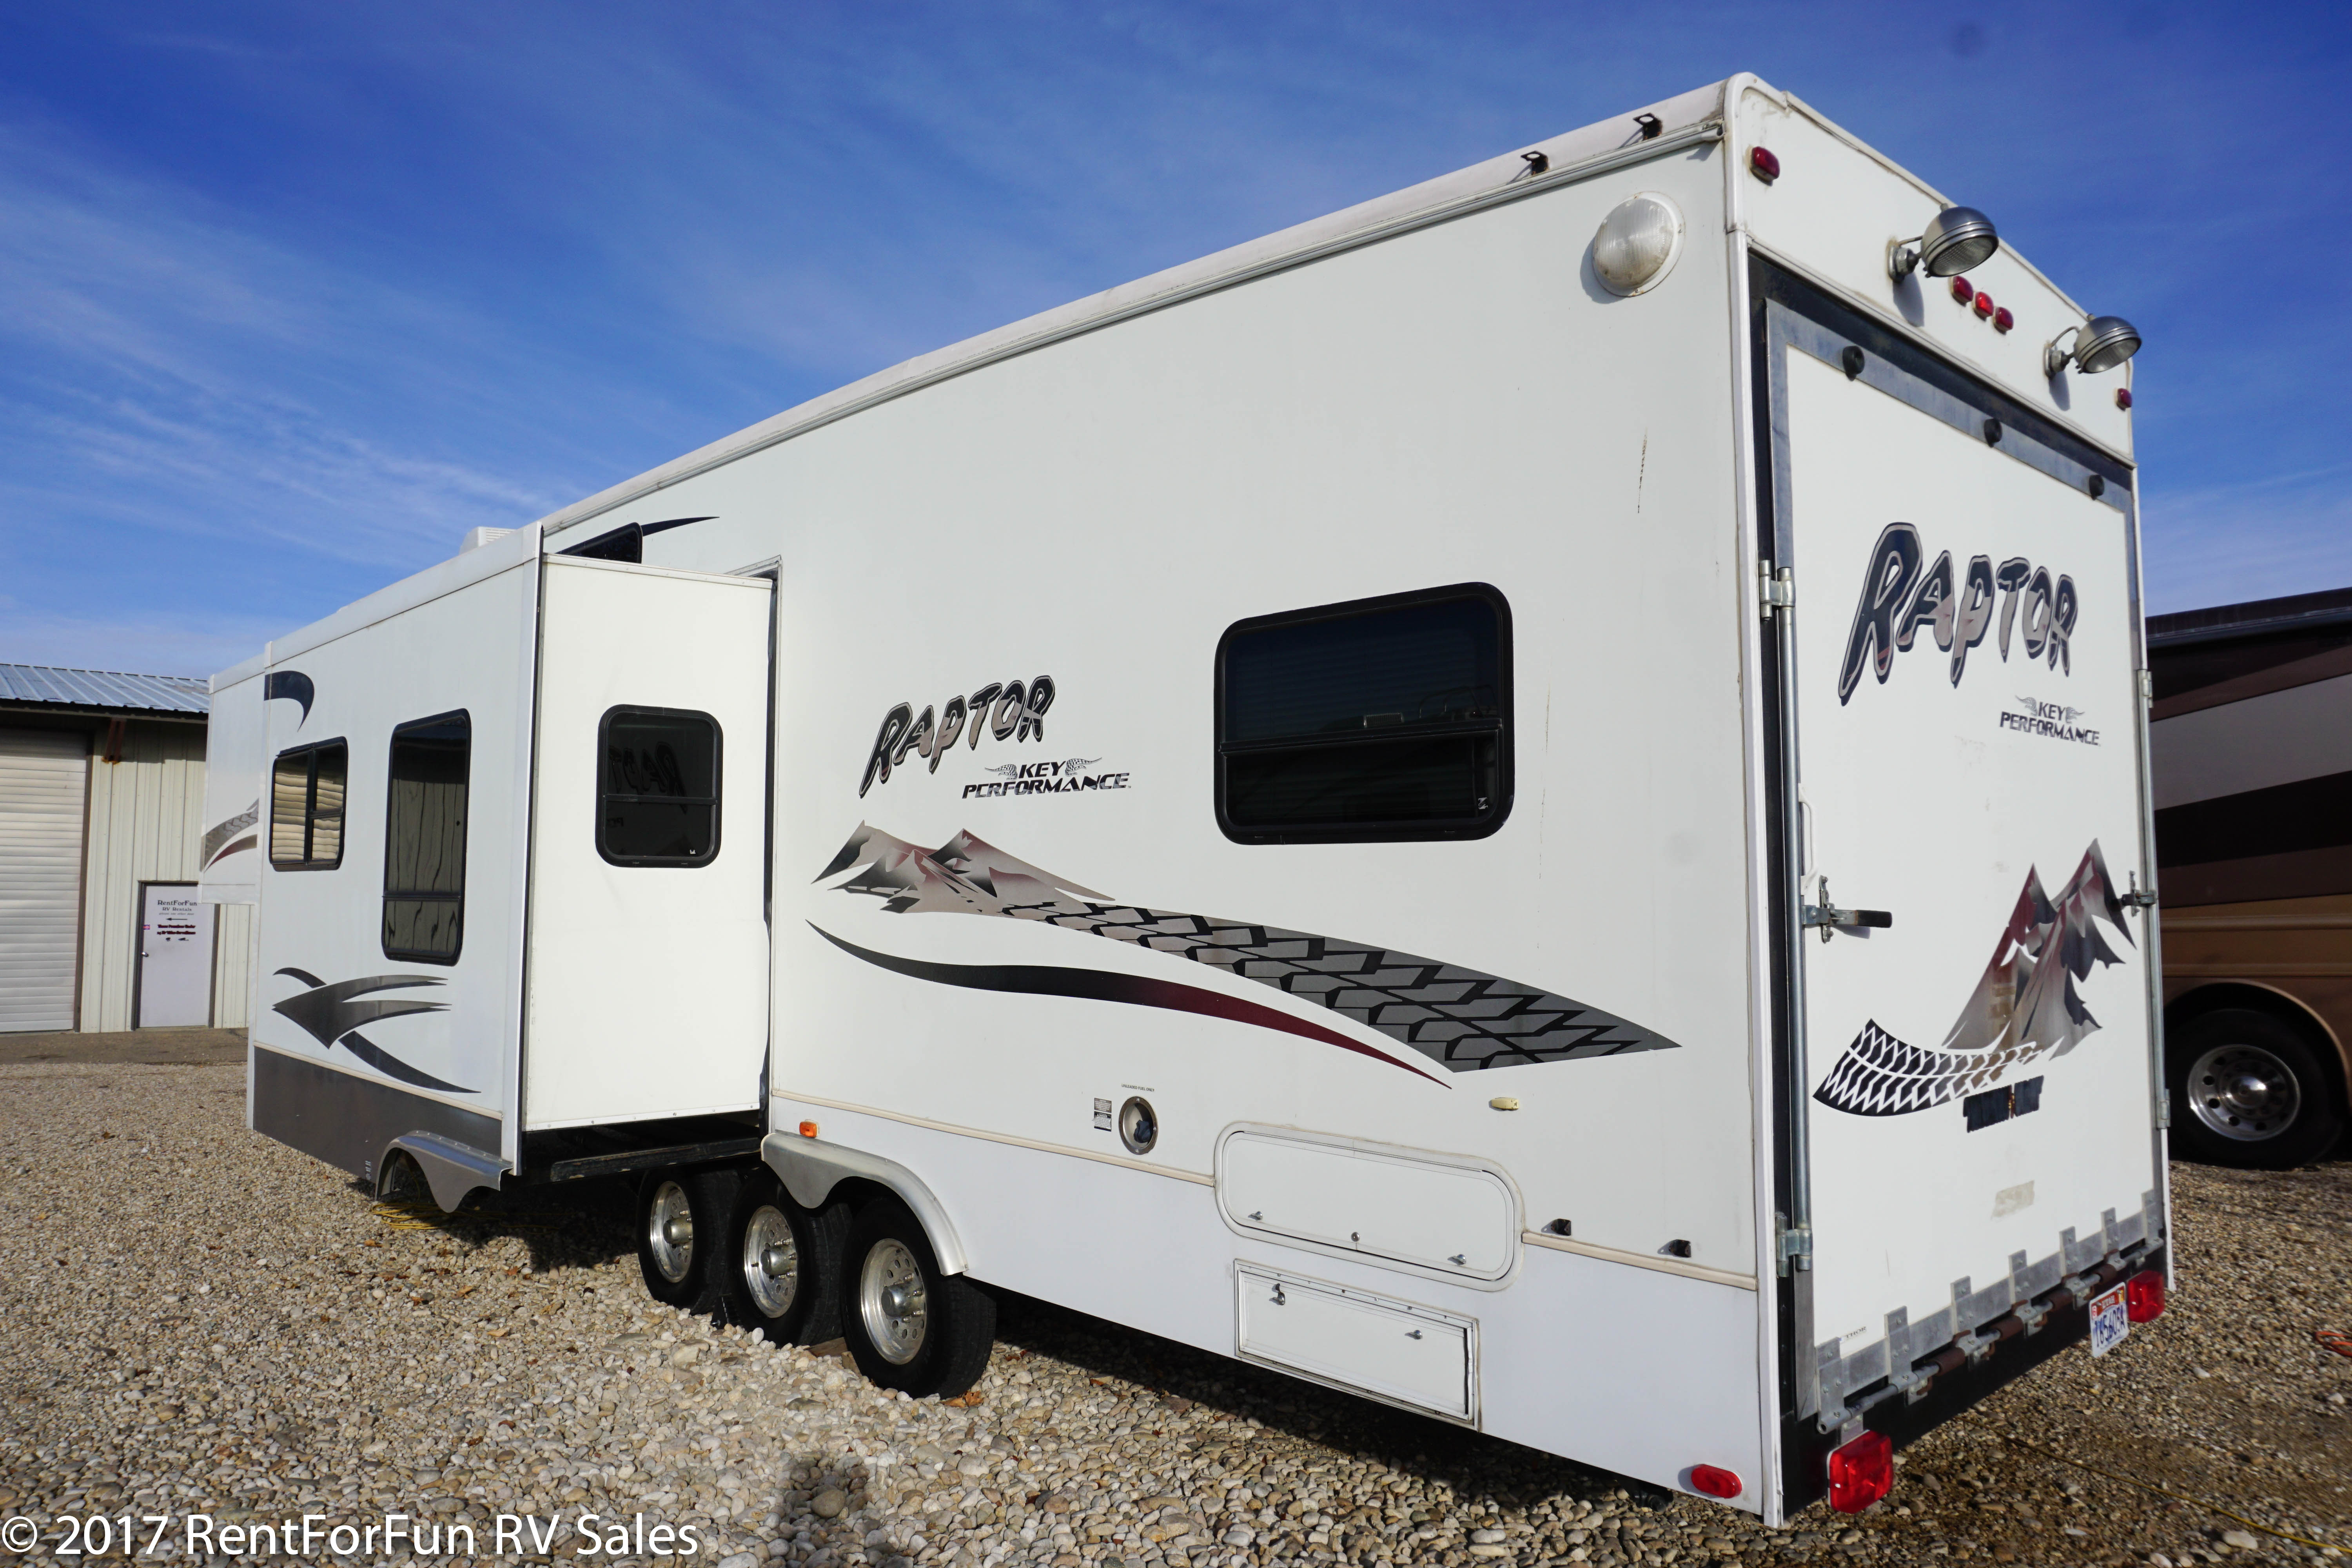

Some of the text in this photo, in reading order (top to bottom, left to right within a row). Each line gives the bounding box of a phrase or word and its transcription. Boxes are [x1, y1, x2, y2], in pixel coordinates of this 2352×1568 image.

[1838, 522, 2078, 706] RAPTOR
[2039, 701, 2066, 721] KEY
[859, 675, 1055, 799] RAPTOR
[2000, 711, 2100, 746] PERFORMANCE
[1019, 761, 1066, 779] KEY
[962, 773, 1130, 799] PERFORMANCE
[2102, 1295, 2115, 1309] UTAH
